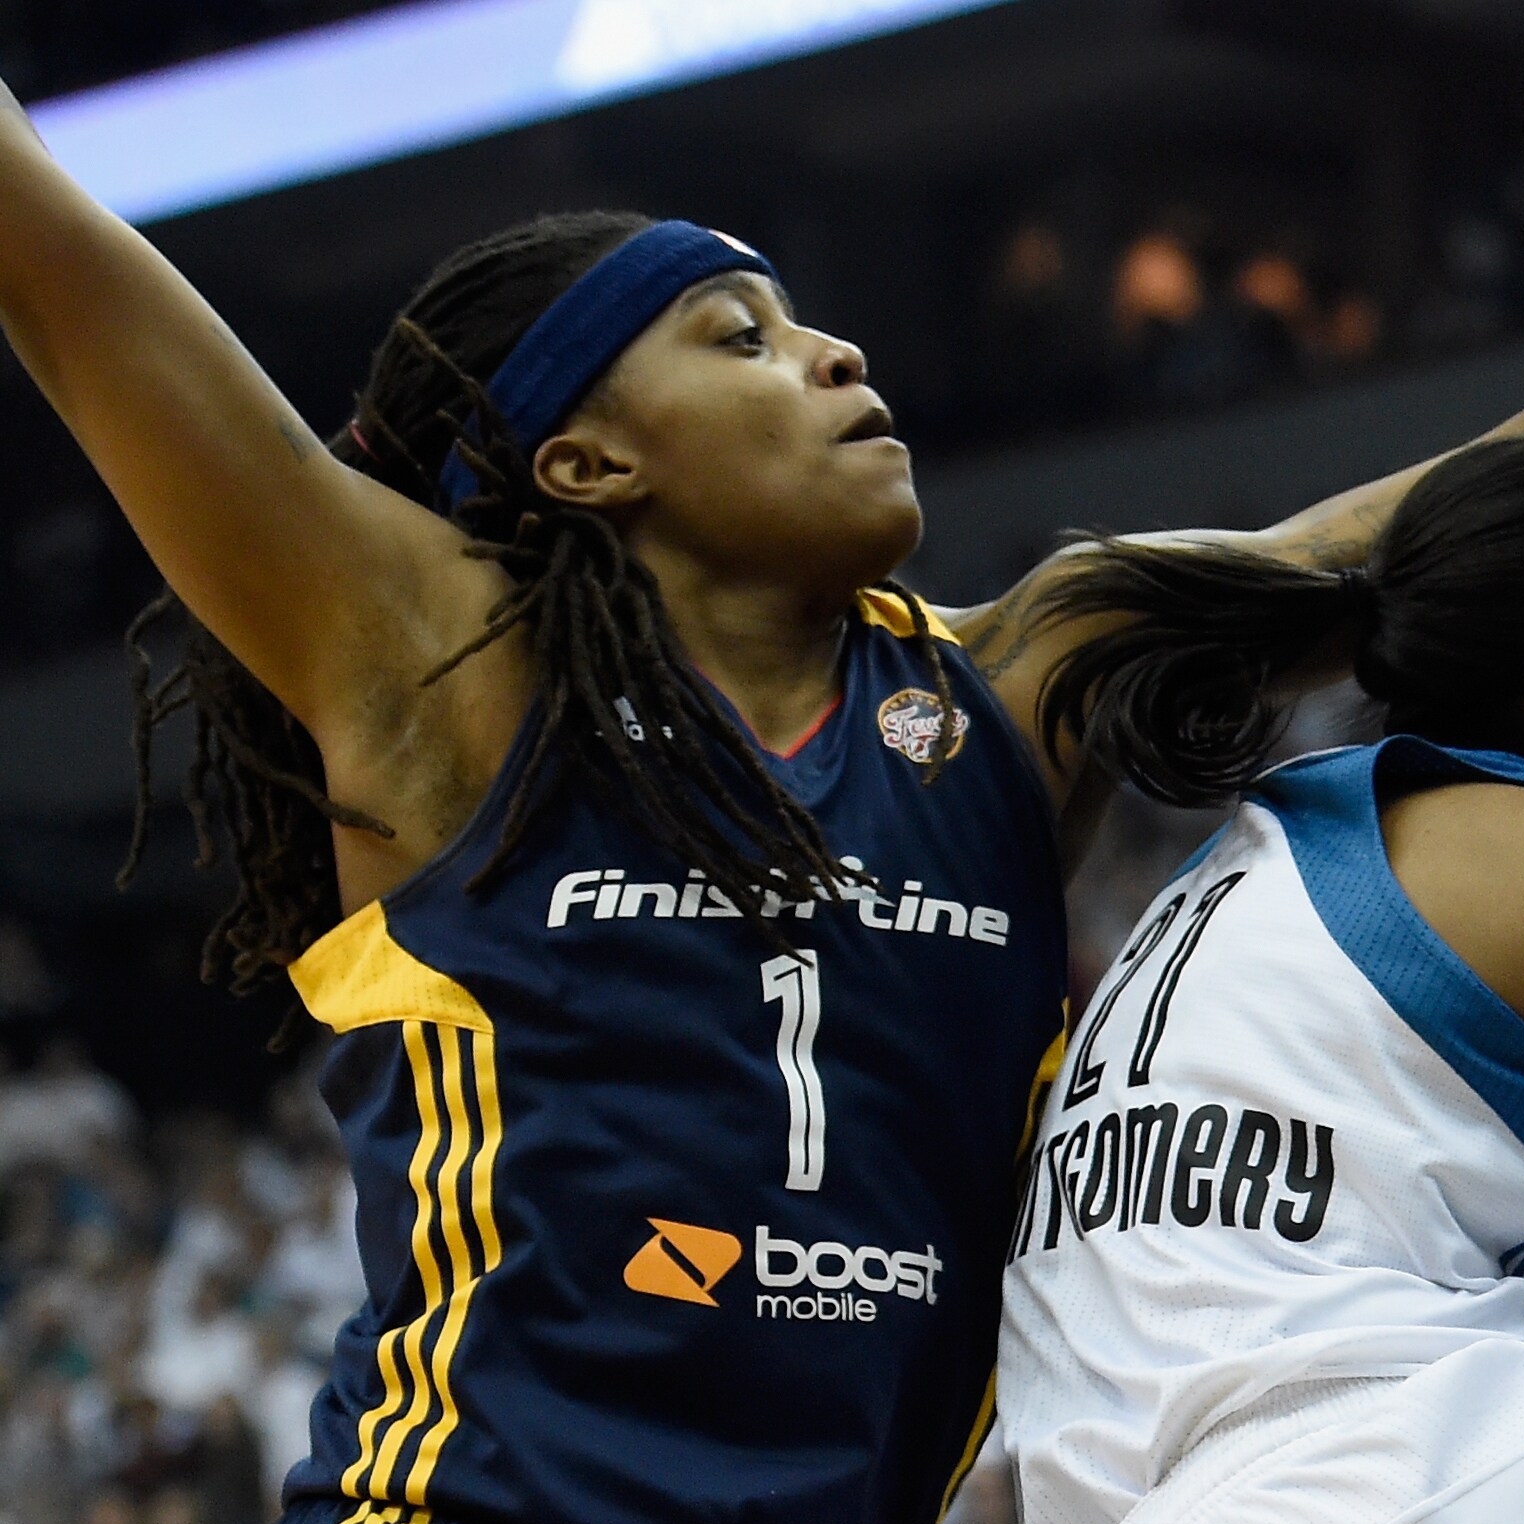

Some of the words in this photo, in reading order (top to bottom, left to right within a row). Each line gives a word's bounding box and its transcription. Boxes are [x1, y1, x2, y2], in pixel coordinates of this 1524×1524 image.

[760, 949, 825, 1191] 1
[1062, 871, 1247, 1111] 21
[755, 1225, 943, 1305] boost
[756, 1291, 877, 1322] mobile
